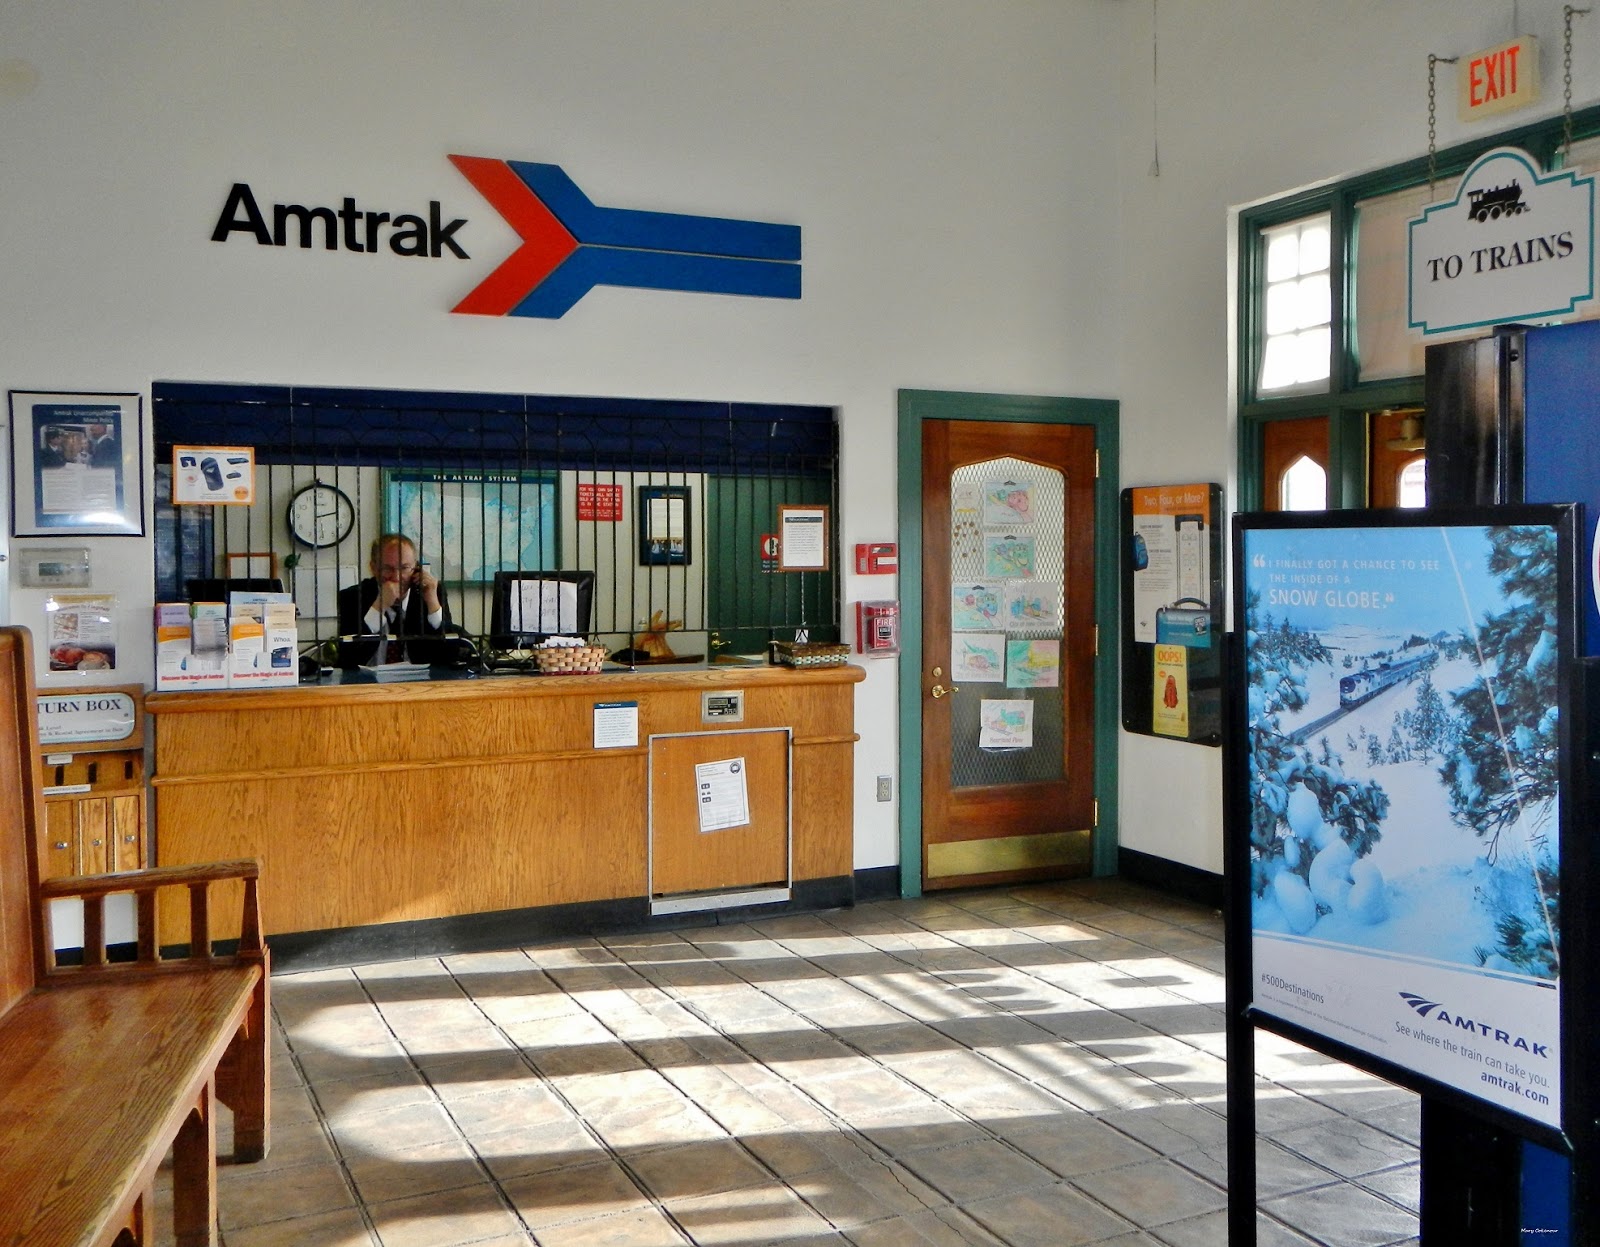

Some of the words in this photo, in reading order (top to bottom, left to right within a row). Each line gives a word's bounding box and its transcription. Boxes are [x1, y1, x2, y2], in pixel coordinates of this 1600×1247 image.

[1469, 45, 1521, 108] EXIT
[209, 182, 472, 261] Amtrak
[1426, 254, 1464, 284] TO
[1470, 231, 1575, 276] TRAINS
[1269, 574, 1286, 582] THE
[1291, 574, 1322, 584] INSIDE
[1326, 575, 1339, 584] OF
[1344, 575, 1351, 584] A
[1276, 559, 1313, 569] FINALLY
[1317, 560, 1337, 569] GOT
[1342, 560, 1349, 569] A
[1353, 560, 1396, 570] CHANCE
[1402, 560, 1415, 570] TO
[1421, 560, 1440, 571] SEE
[1269, 588, 1318, 607] SNOW
[876, 618, 894, 626] FIRE
[1158, 650, 1182, 663] OOPS!
[87, 699, 121, 711] BOX
[1261, 972, 1325, 1004] #500Destinations
[1437, 1010, 1549, 1059] AMTRAK
[1395, 1021, 1411, 1036] See
[1413, 1028, 1440, 1048] where
[1443, 1038, 1458, 1054] the
[1460, 1045, 1483, 1063] train
[1485, 1055, 1502, 1070] can
[1505, 1061, 1526, 1079] take
[1528, 1070, 1551, 1089] you.
[1480, 1071, 1550, 1106] amtrak.com
